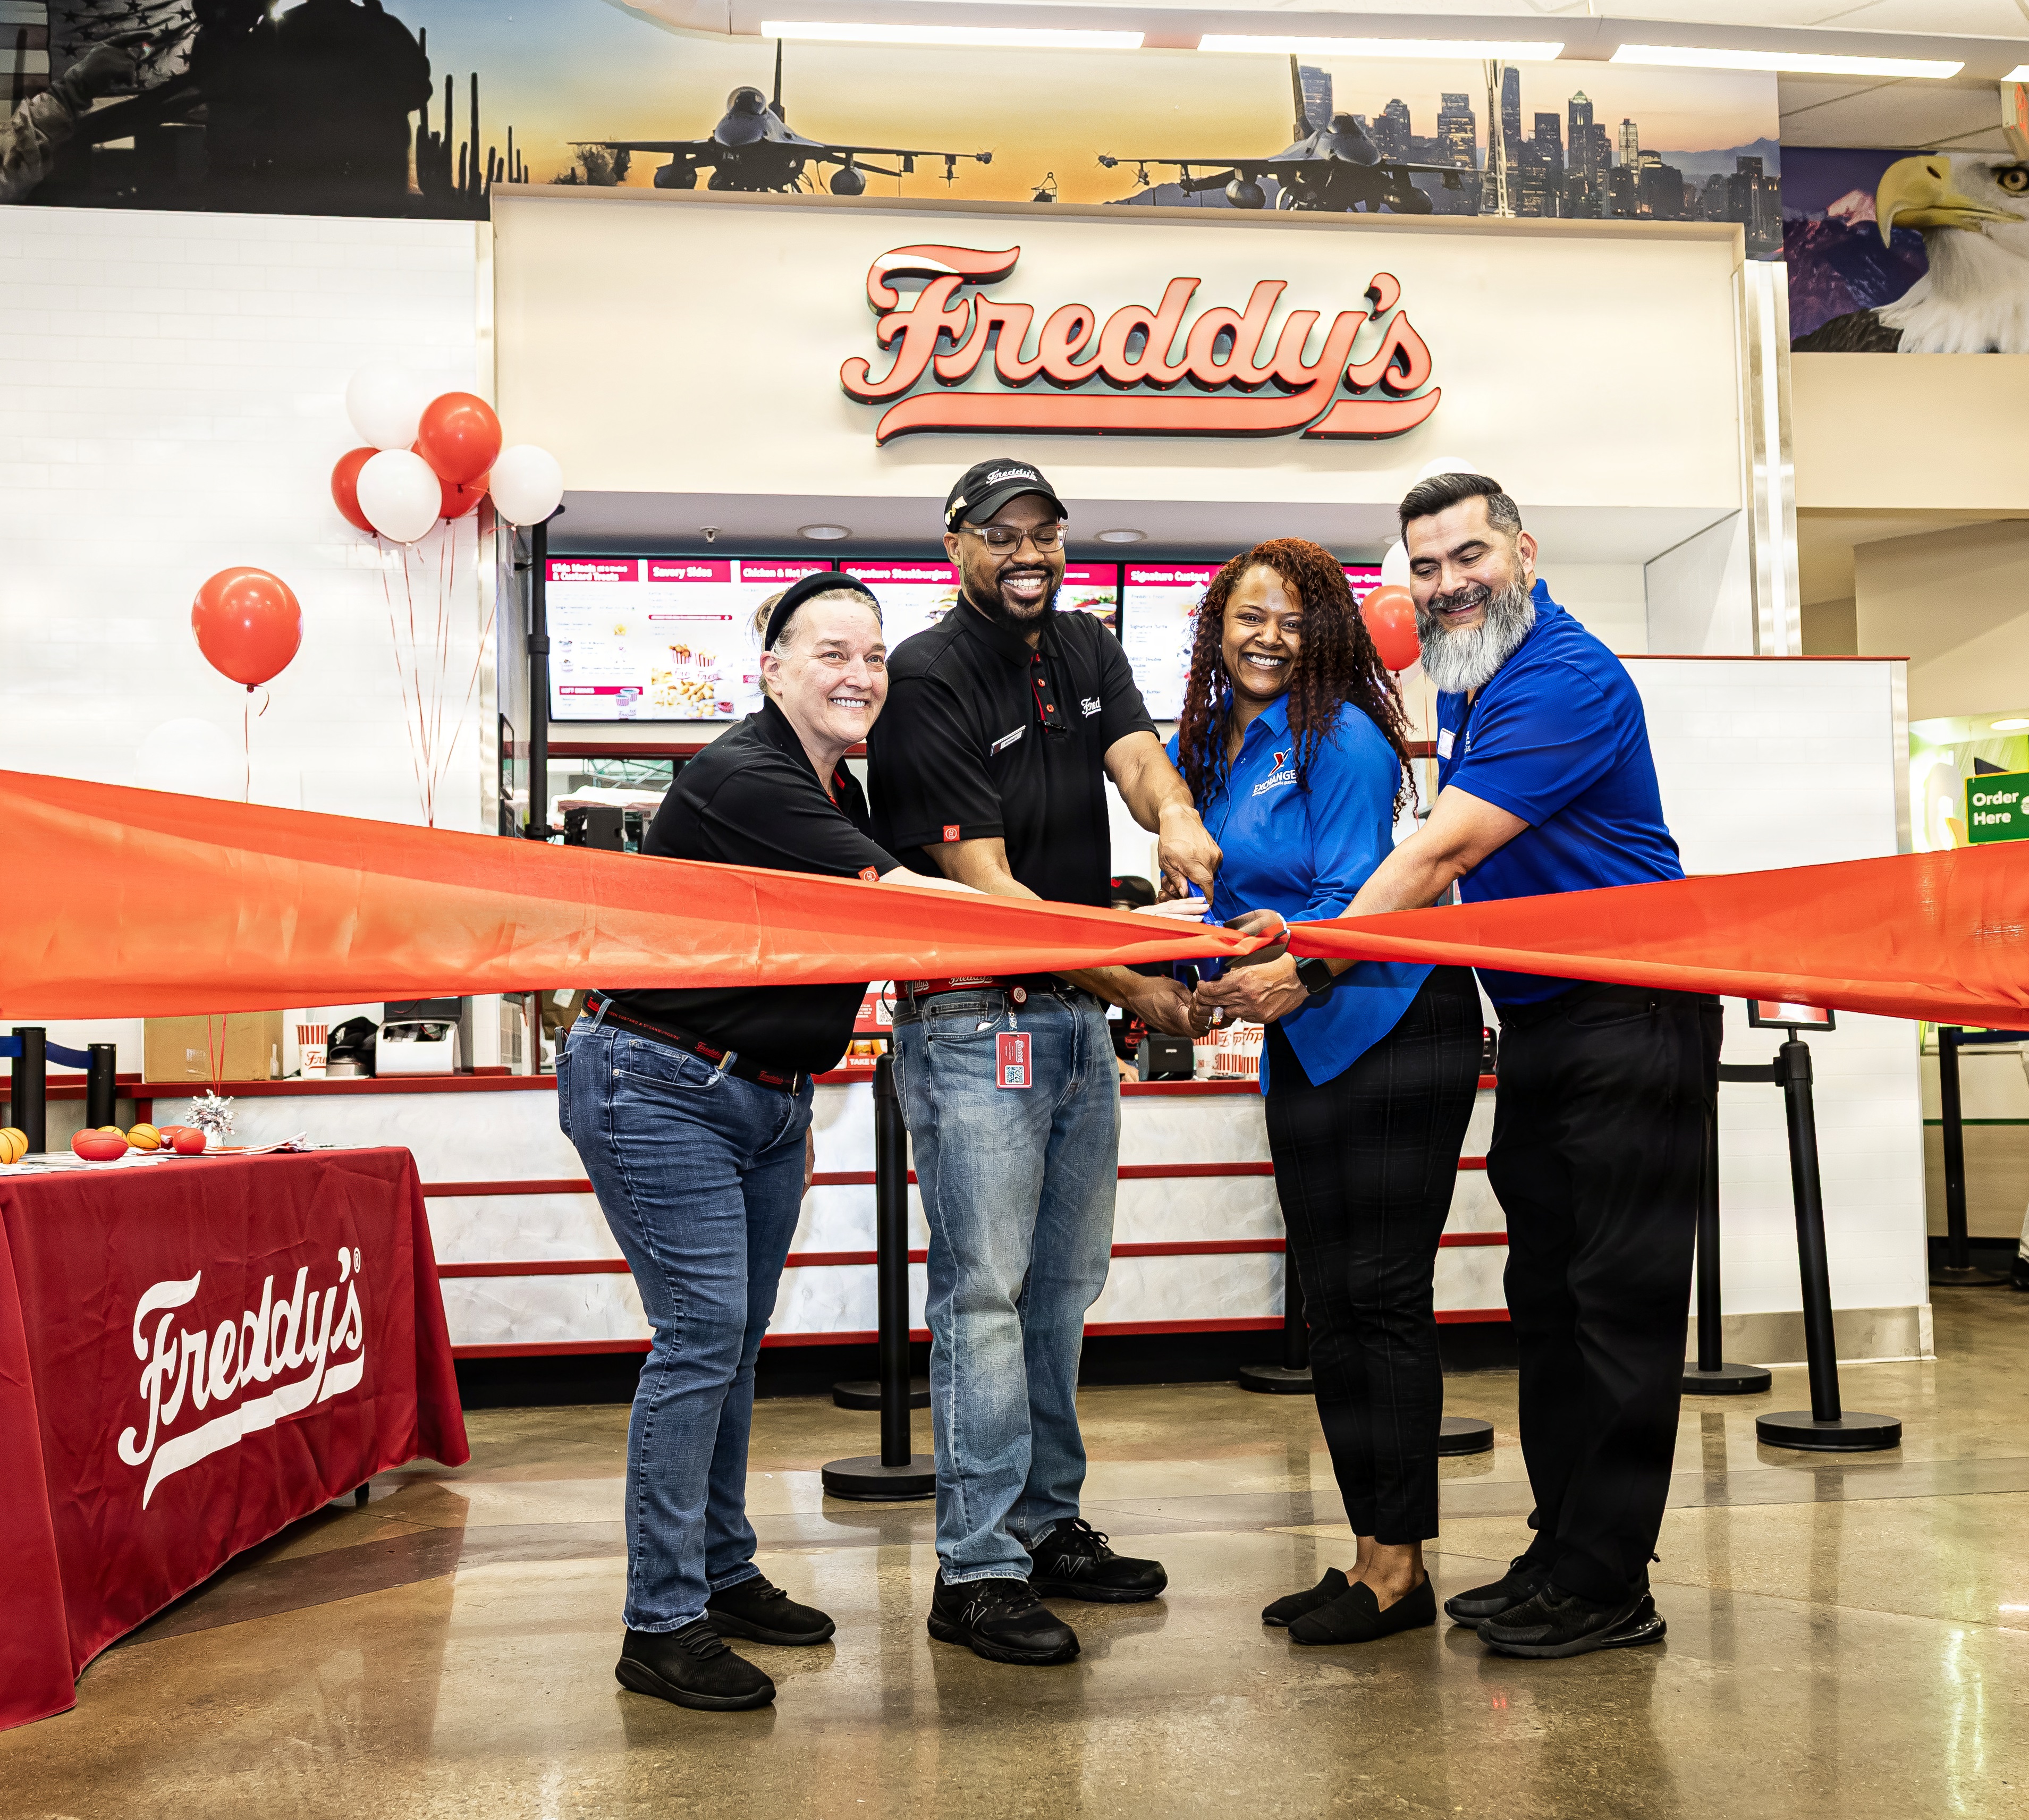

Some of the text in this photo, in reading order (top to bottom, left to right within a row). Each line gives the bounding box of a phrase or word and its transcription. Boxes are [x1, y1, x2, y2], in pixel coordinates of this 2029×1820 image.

[840, 244, 1441, 446] Freddy's
[986, 468, 1038, 486] Freddy's
[653, 566, 712, 579] Savory Sides
[743, 568, 776, 577] Chicken
[777, 568, 784, 578] &
[785, 568, 800, 578] Hot
[892, 568, 952, 581] Steakburgers
[1130, 570, 1209, 583] Signature Custard
[1253, 769, 1297, 793] EXCHANGE
[1973, 790, 2019, 806] Order
[1974, 811, 2011, 825] Here
[1015, 1039, 1024, 1063] Freddy's
